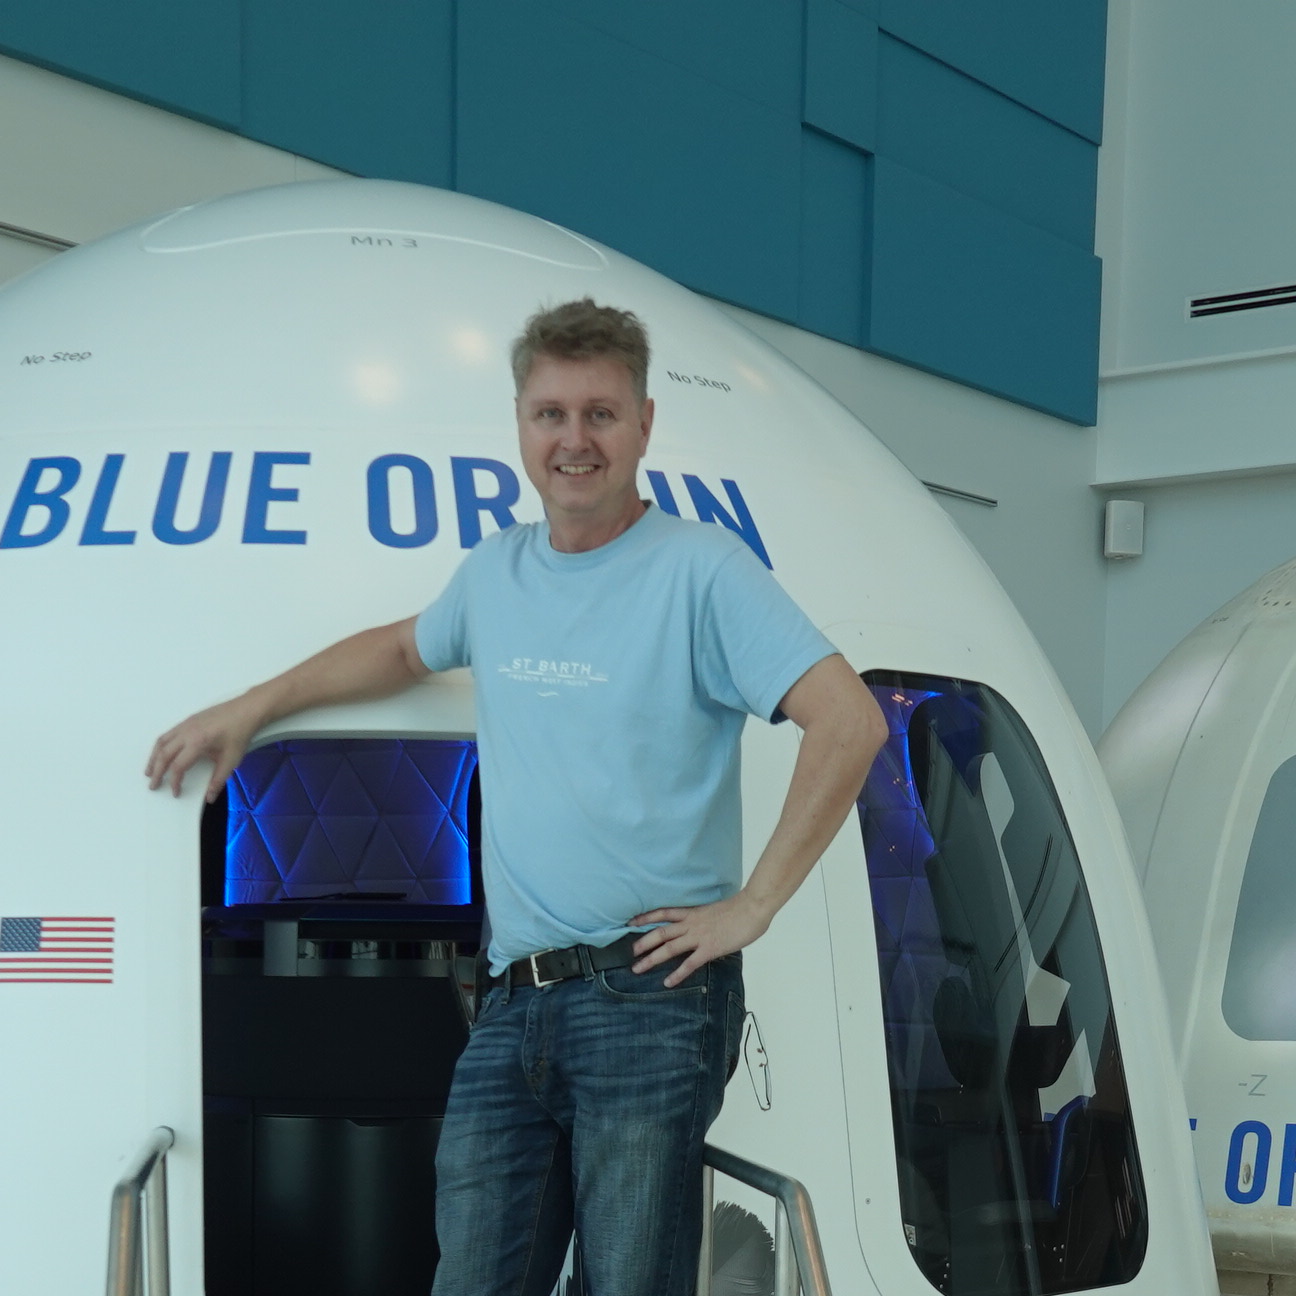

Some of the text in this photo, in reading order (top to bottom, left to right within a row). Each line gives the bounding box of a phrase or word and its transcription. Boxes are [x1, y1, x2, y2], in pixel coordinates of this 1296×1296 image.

[20, 351, 92, 366] No Step
[666, 369, 732, 393] No Step
[366, 454, 774, 571] ORIN
[512, 658, 532, 670] ST
[539, 659, 592, 675] BARTH
[1238, 1074, 1268, 1097] -Z
